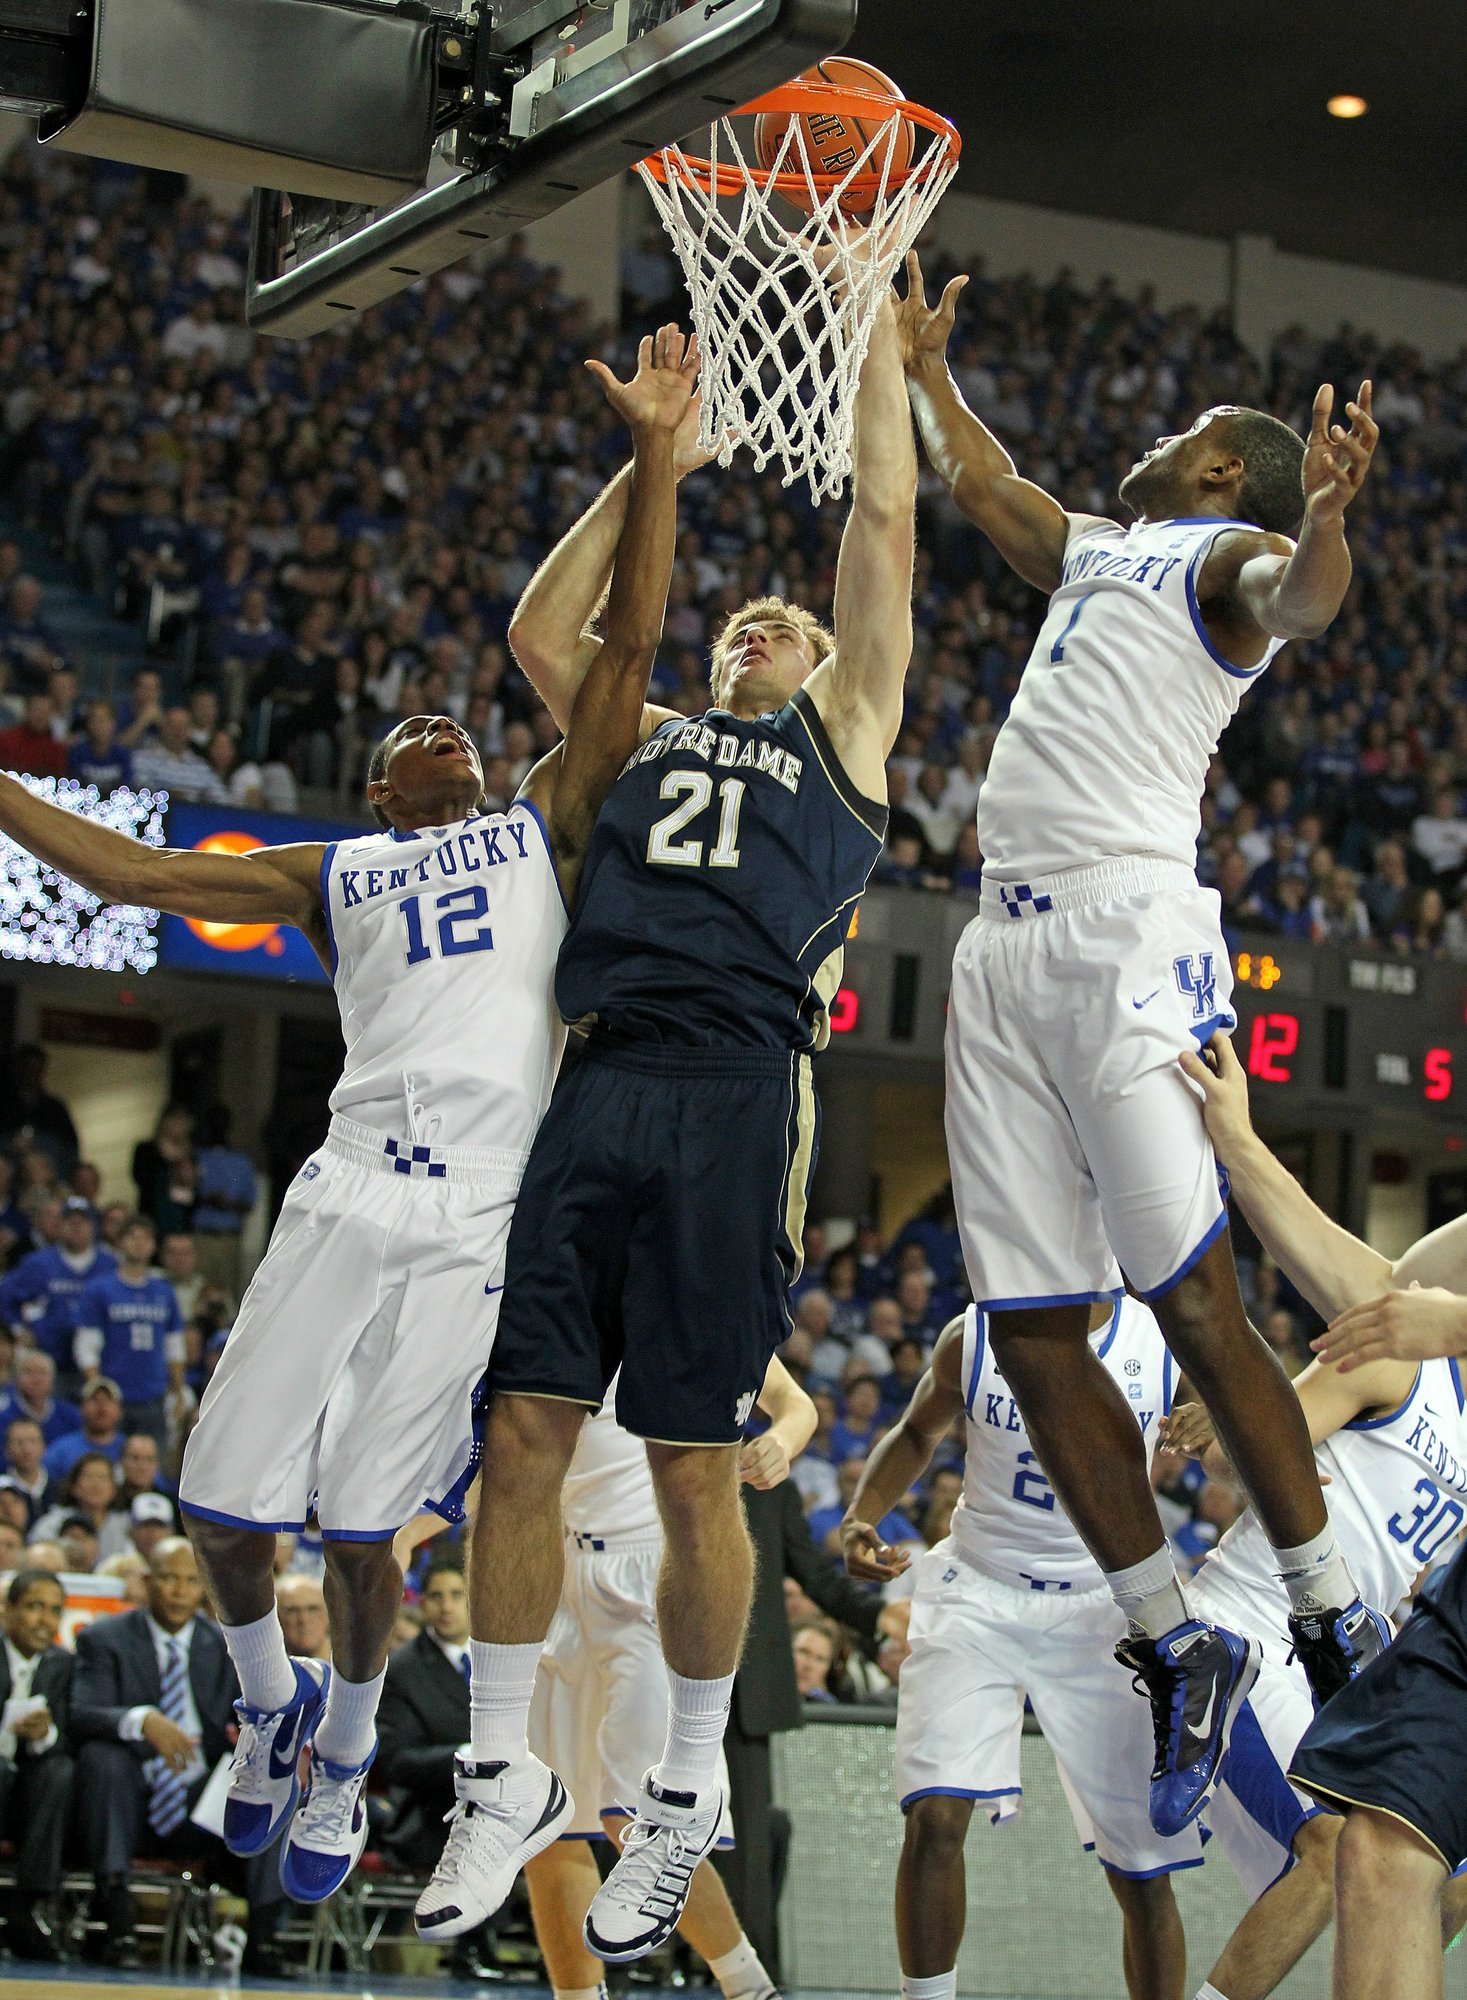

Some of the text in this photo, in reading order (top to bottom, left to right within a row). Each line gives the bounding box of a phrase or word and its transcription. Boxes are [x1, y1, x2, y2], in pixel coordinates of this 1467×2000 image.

[1050, 590, 1099, 663] 1
[714, 733, 803, 795] DAME
[645, 769, 747, 868] 21
[340, 822, 528, 908] KENTUCKY
[398, 885, 494, 966] 12
[1249, 1012, 1299, 1082] 12
[1424, 1048, 1453, 1101] 5
[1387, 1477, 1464, 1563] 30
